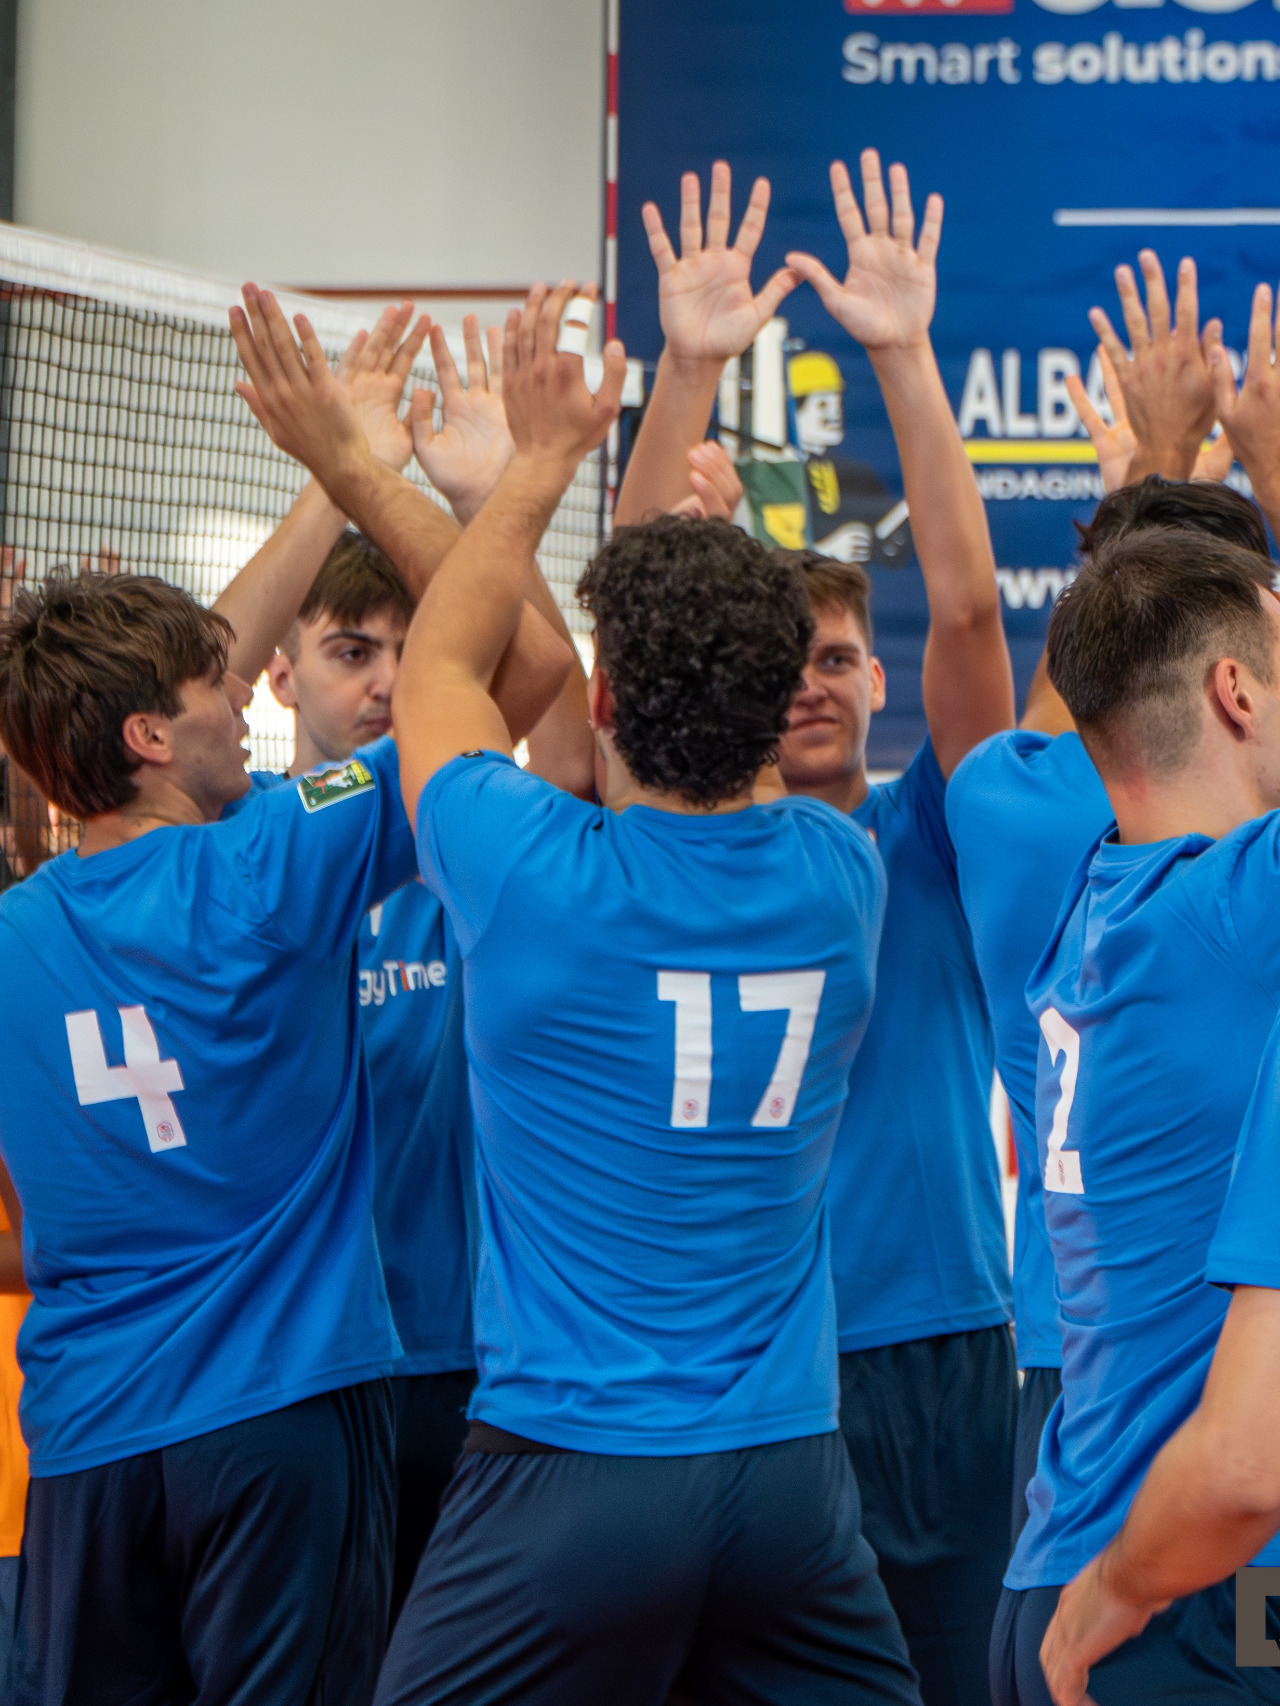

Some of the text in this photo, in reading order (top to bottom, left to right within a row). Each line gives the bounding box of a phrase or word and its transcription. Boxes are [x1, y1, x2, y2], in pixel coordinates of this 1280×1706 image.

[841, 31, 1022, 85] Smart
[957, 347, 1115, 438] ALBA
[358, 960, 446, 1006] gyTime
[64, 1004, 188, 1154] 4
[657, 969, 826, 1127] 17
